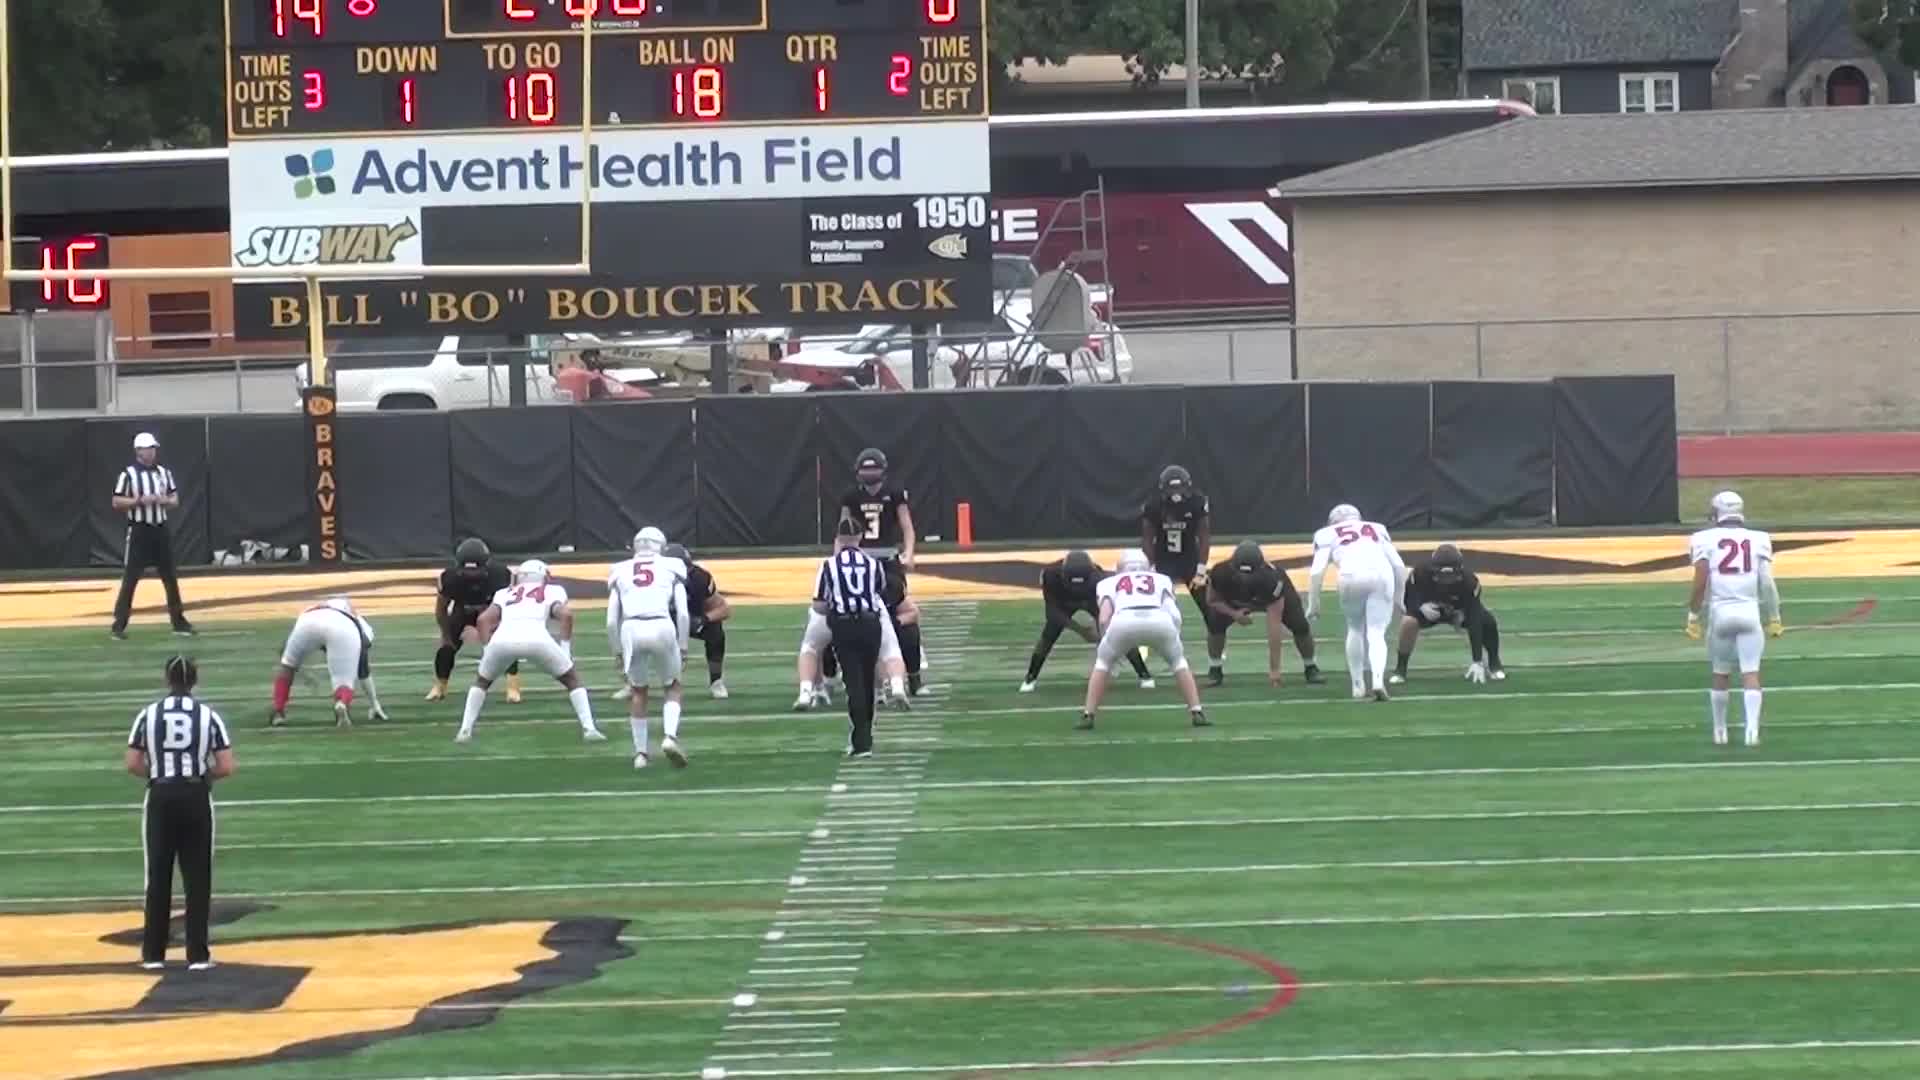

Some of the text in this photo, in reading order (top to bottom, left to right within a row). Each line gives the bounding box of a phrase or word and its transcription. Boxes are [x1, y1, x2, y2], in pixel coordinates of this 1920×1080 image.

[356, 46, 437, 73] DOWN
[482, 42, 561, 70] TO GO
[639, 37, 735, 66] BALL ON
[786, 35, 837, 61] QTR
[920, 36, 971, 58] TIME
[240, 55, 291, 77] TIME
[890, 56, 910, 93] 2
[920, 61, 977, 84] OUTS
[235, 80, 292, 103] OUTS
[303, 73, 323, 109] 3
[401, 80, 412, 122] 1
[507, 73, 554, 121] 10
[675, 68, 721, 116] 18
[816, 68, 826, 111] 1
[920, 88, 971, 110] LEFT
[240, 105, 292, 129] LEFT
[351, 136, 901, 195] AdventHealth Field
[810, 211, 902, 231] The Class of
[913, 196, 986, 228] 1950
[237, 220, 414, 267] SUBWAY
[270, 279, 958, 327] BLL "BO" BOUCEK TRACK
[315, 424, 337, 560] BRAVES
[864, 511, 880, 540] 3
[1334, 524, 1379, 545] 54
[1718, 538, 1752, 575] 21
[633, 561, 655, 587] 5
[841, 566, 867, 595] U
[1115, 574, 1156, 596] 43
[162, 712, 193, 749] B
